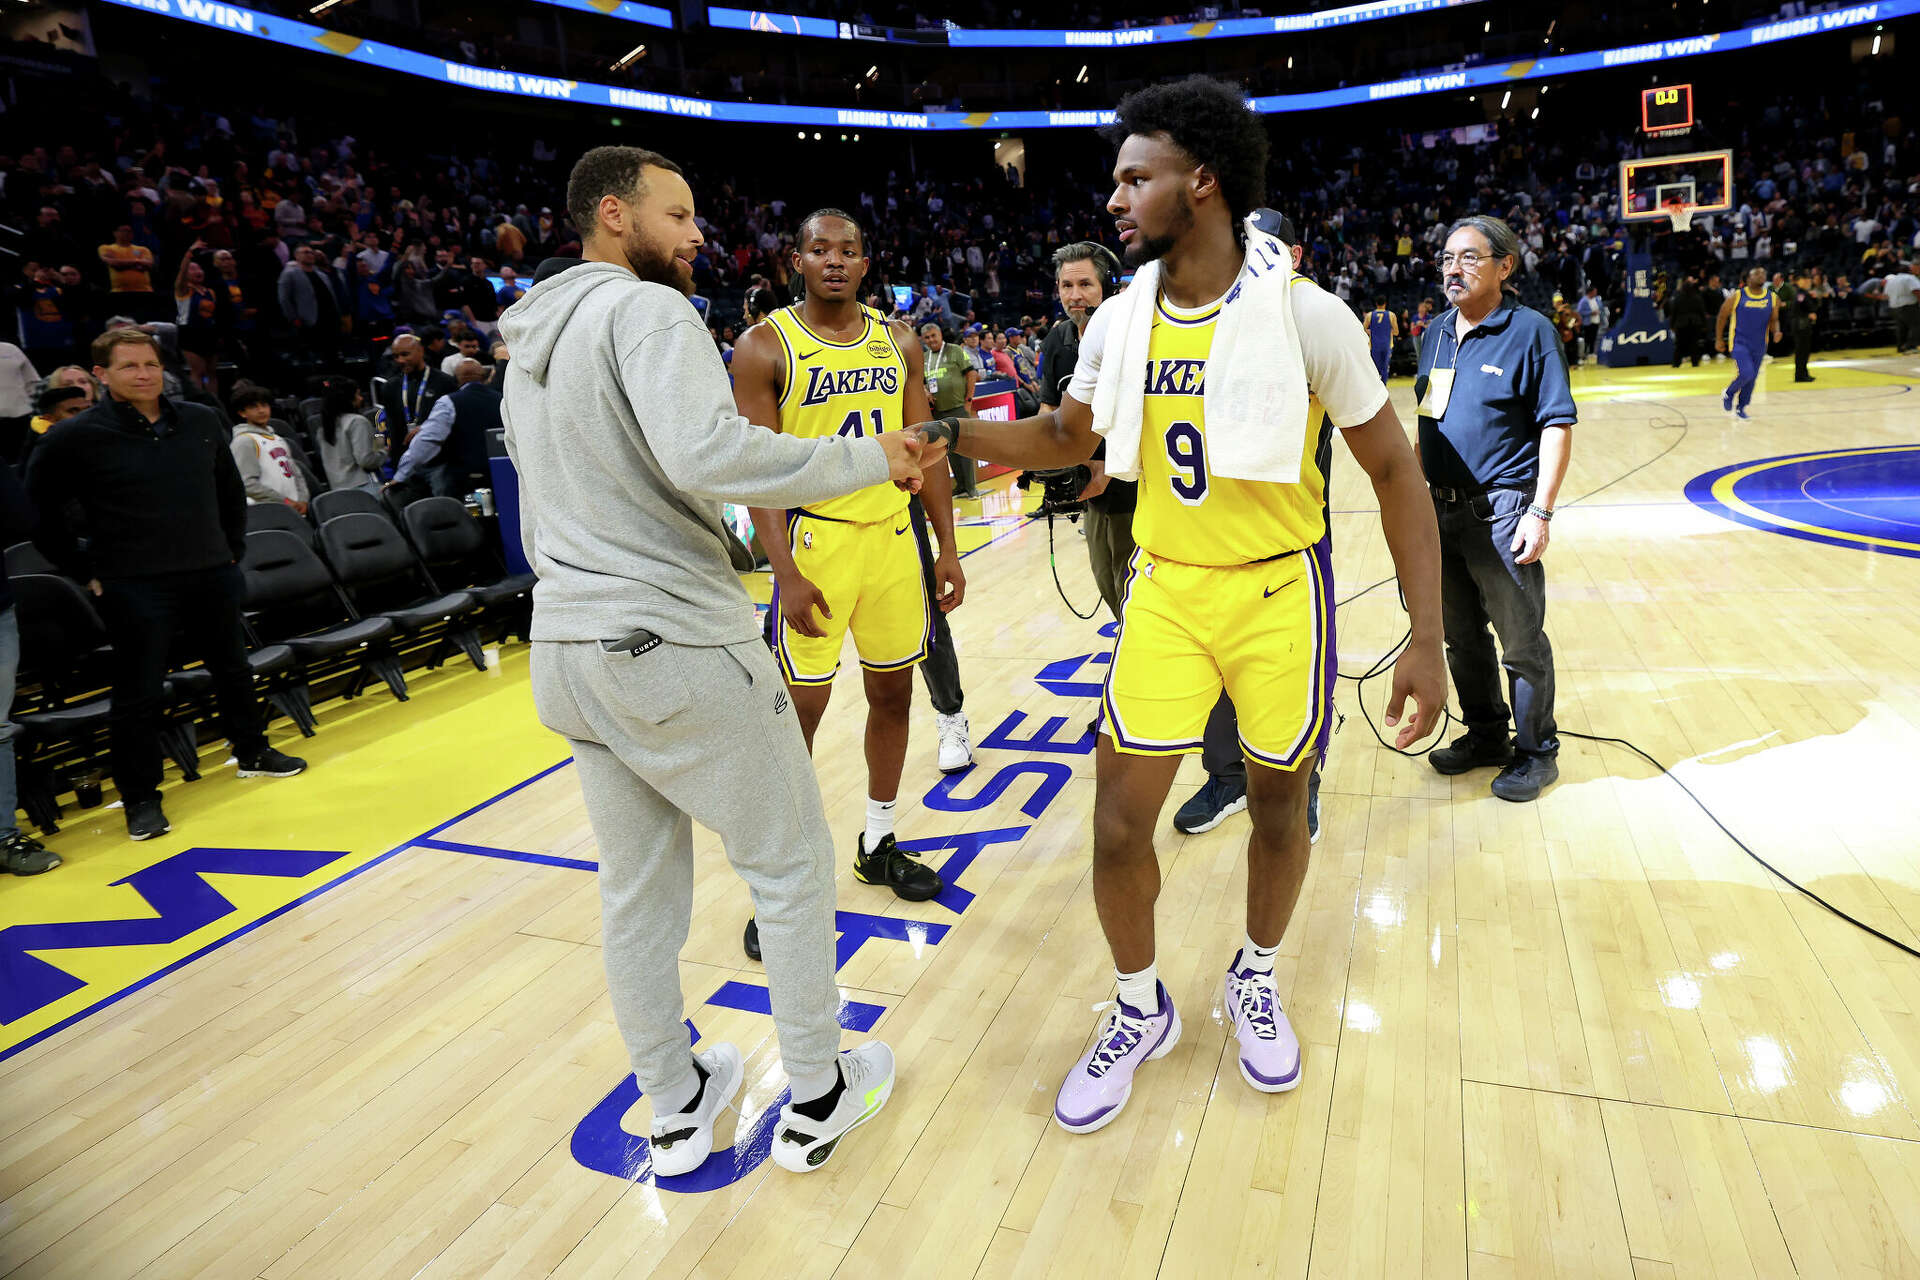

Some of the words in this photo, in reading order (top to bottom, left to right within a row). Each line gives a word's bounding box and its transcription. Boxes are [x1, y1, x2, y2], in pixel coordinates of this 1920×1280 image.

[176, 0, 254, 32] WIN
[1822, 4, 1878, 29] WIN
[1115, 29, 1153, 45] WIN
[1666, 35, 1713, 56] WIN
[518, 76, 571, 98] WIN
[1424, 73, 1466, 91] WIN
[670, 98, 712, 117] WIN
[890, 114, 928, 128] WIN
[800, 366, 898, 407] LAKERS
[837, 408, 884, 438] 41
[1165, 421, 1209, 506] 9
[634, 638, 658, 654] CURRY
